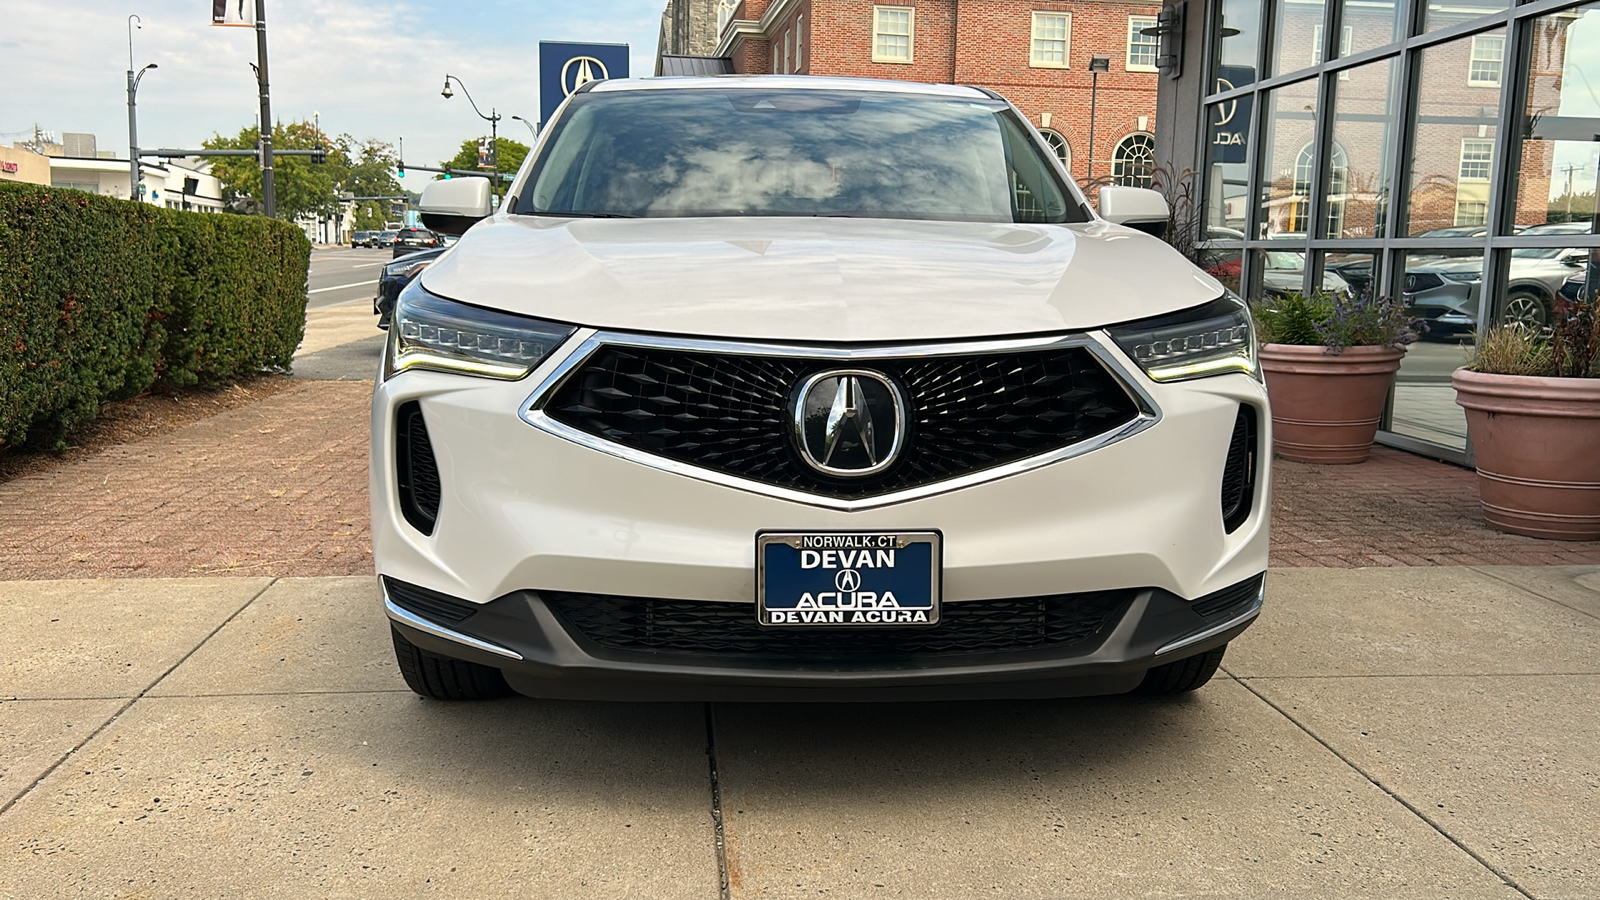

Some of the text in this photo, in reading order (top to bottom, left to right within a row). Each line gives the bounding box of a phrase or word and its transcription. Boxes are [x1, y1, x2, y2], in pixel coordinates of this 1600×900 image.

[804, 536, 896, 547] NORWALK, CT
[801, 550, 895, 569] DEVAN
[797, 592, 899, 608] ACURA
[771, 611, 928, 623] DEVAN ACURA
